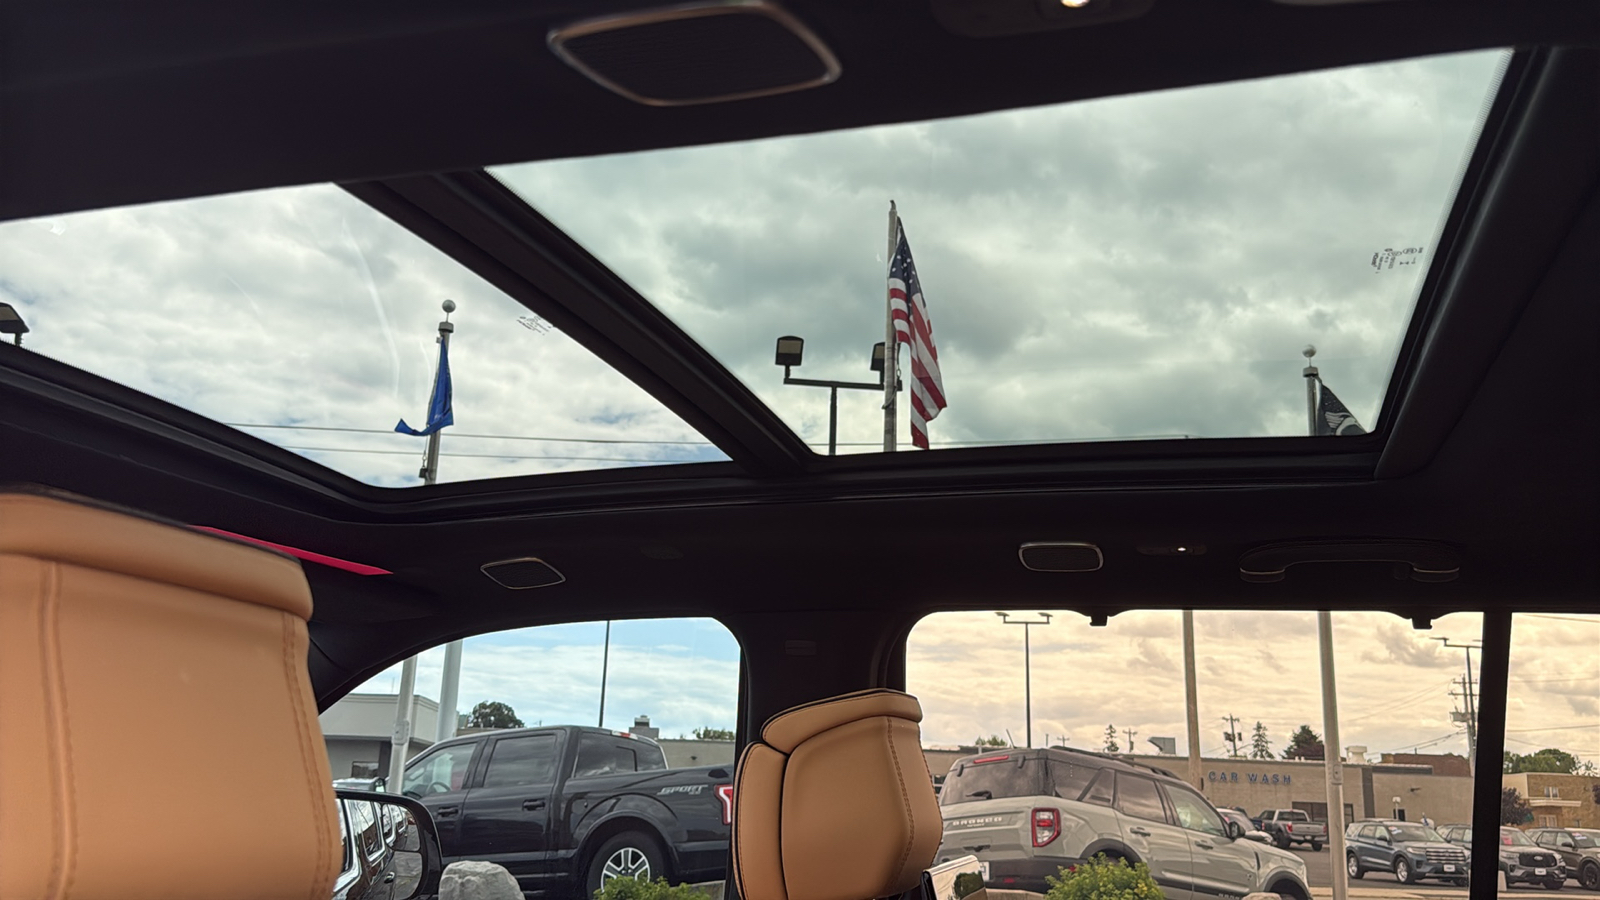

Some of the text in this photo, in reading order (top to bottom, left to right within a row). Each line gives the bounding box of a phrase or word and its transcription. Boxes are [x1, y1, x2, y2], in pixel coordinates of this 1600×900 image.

[1208, 771, 1291, 785] CAR WASH
[656, 784, 709, 796] SPORT
